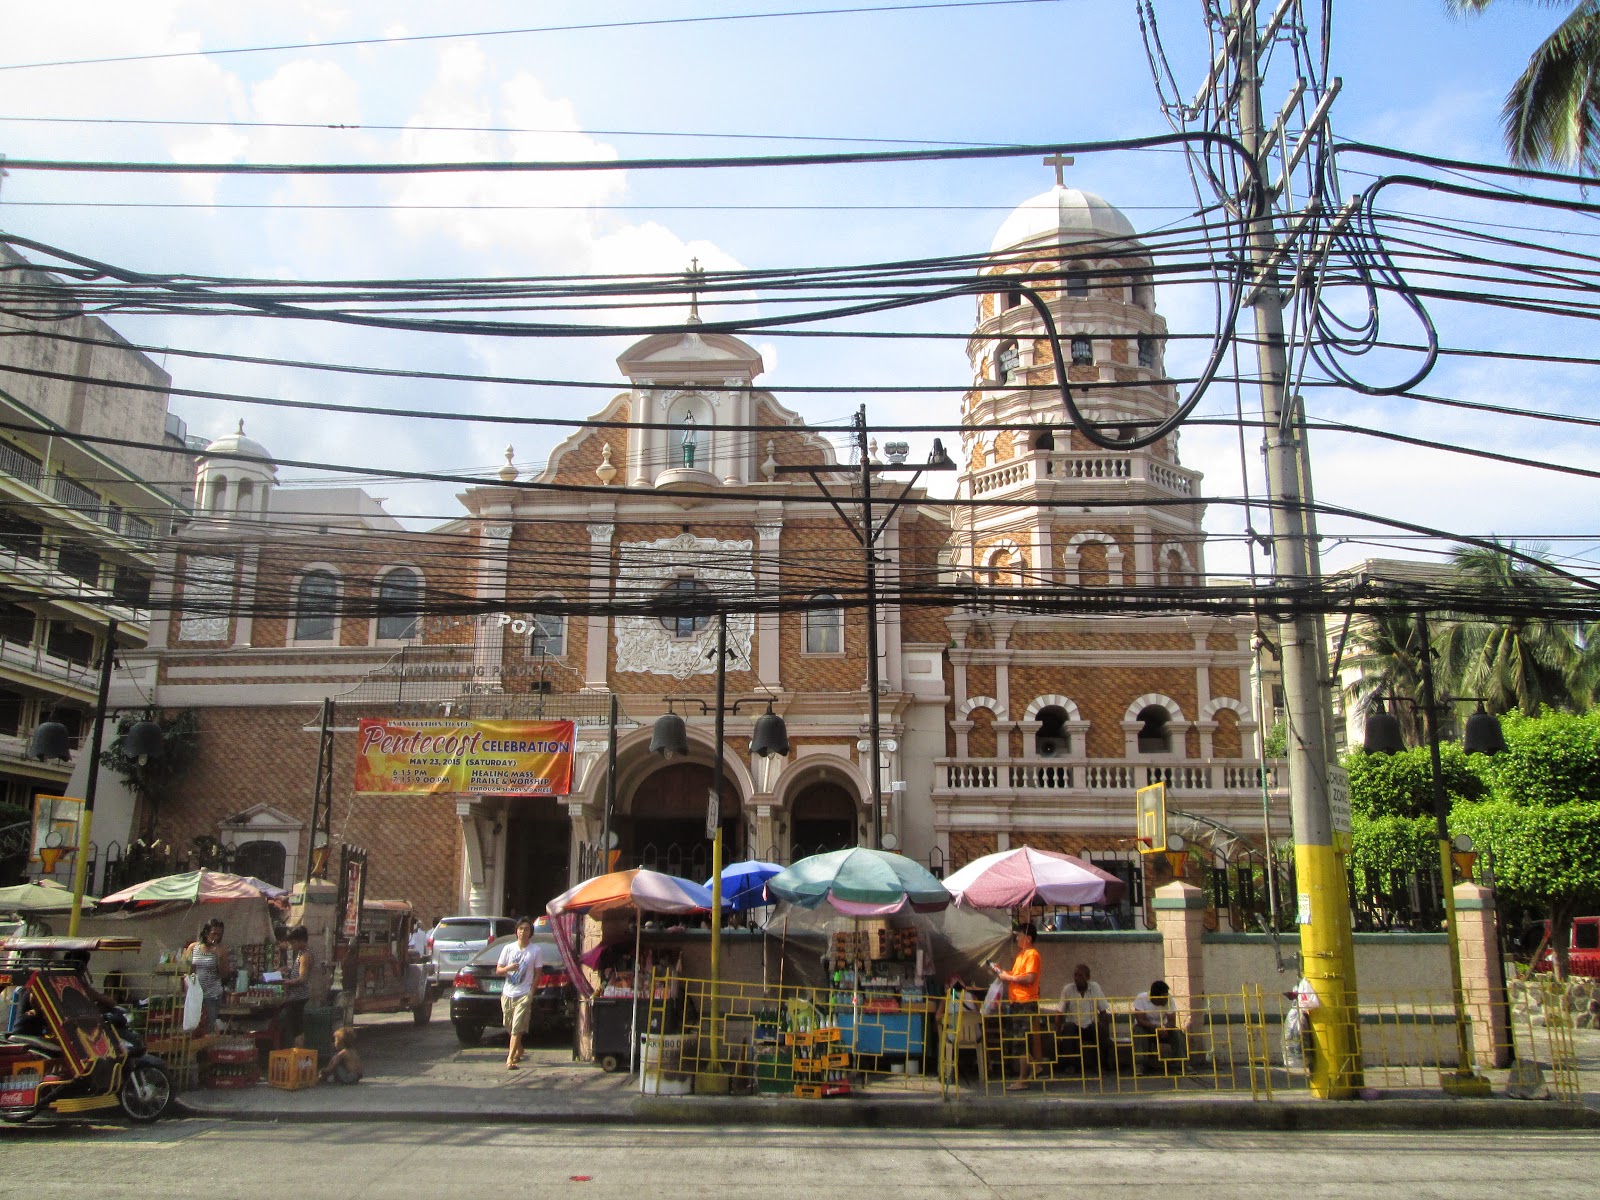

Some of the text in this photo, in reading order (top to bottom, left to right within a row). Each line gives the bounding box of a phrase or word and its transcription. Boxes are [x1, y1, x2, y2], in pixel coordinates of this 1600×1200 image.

[497, 613, 536, 635] PO,
[466, 665, 485, 677] NG
[491, 665, 554, 677] PAROKYA
[482, 700, 546, 718] CRUZ
[362, 726, 571, 757] Pentecost CELEBRATION
[409, 758, 517, 768] MAY 23, 2015 (SATURDAY)
[414, 769, 428, 777] PM
[471, 770, 509, 778] HEALING
[470, 777, 500, 785] PRAISE
[1333, 788, 1348, 803] ZONE
